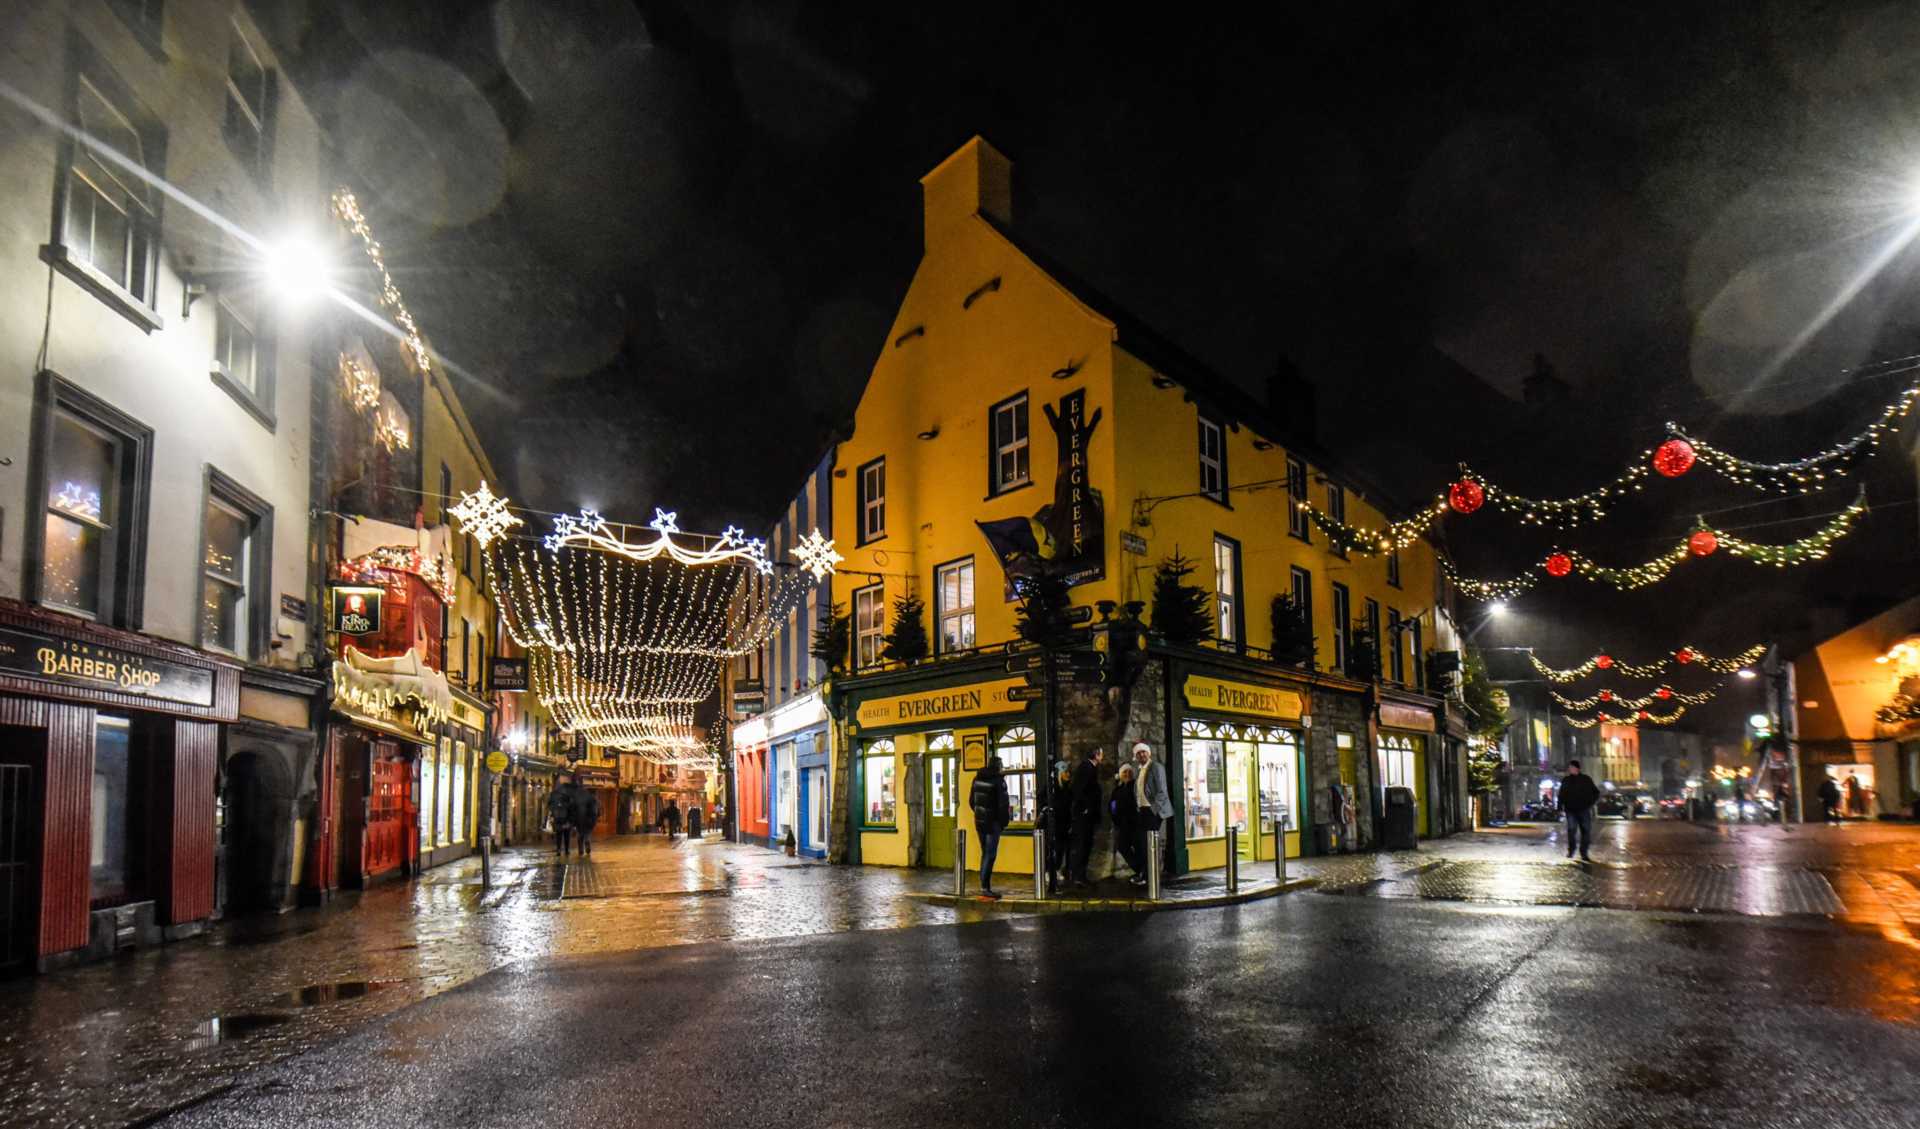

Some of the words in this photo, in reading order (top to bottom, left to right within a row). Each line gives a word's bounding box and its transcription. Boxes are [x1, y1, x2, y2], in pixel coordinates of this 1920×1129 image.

[1071, 399, 1082, 556] EVERGREEN
[37, 647, 117, 681] BARBER
[119, 663, 161, 688] SHOP
[863, 707, 890, 720] HEALTH
[898, 689, 982, 719] EVERGREEN
[1188, 685, 1213, 698] HEALTH
[1217, 684, 1280, 712] EVERGREEN
